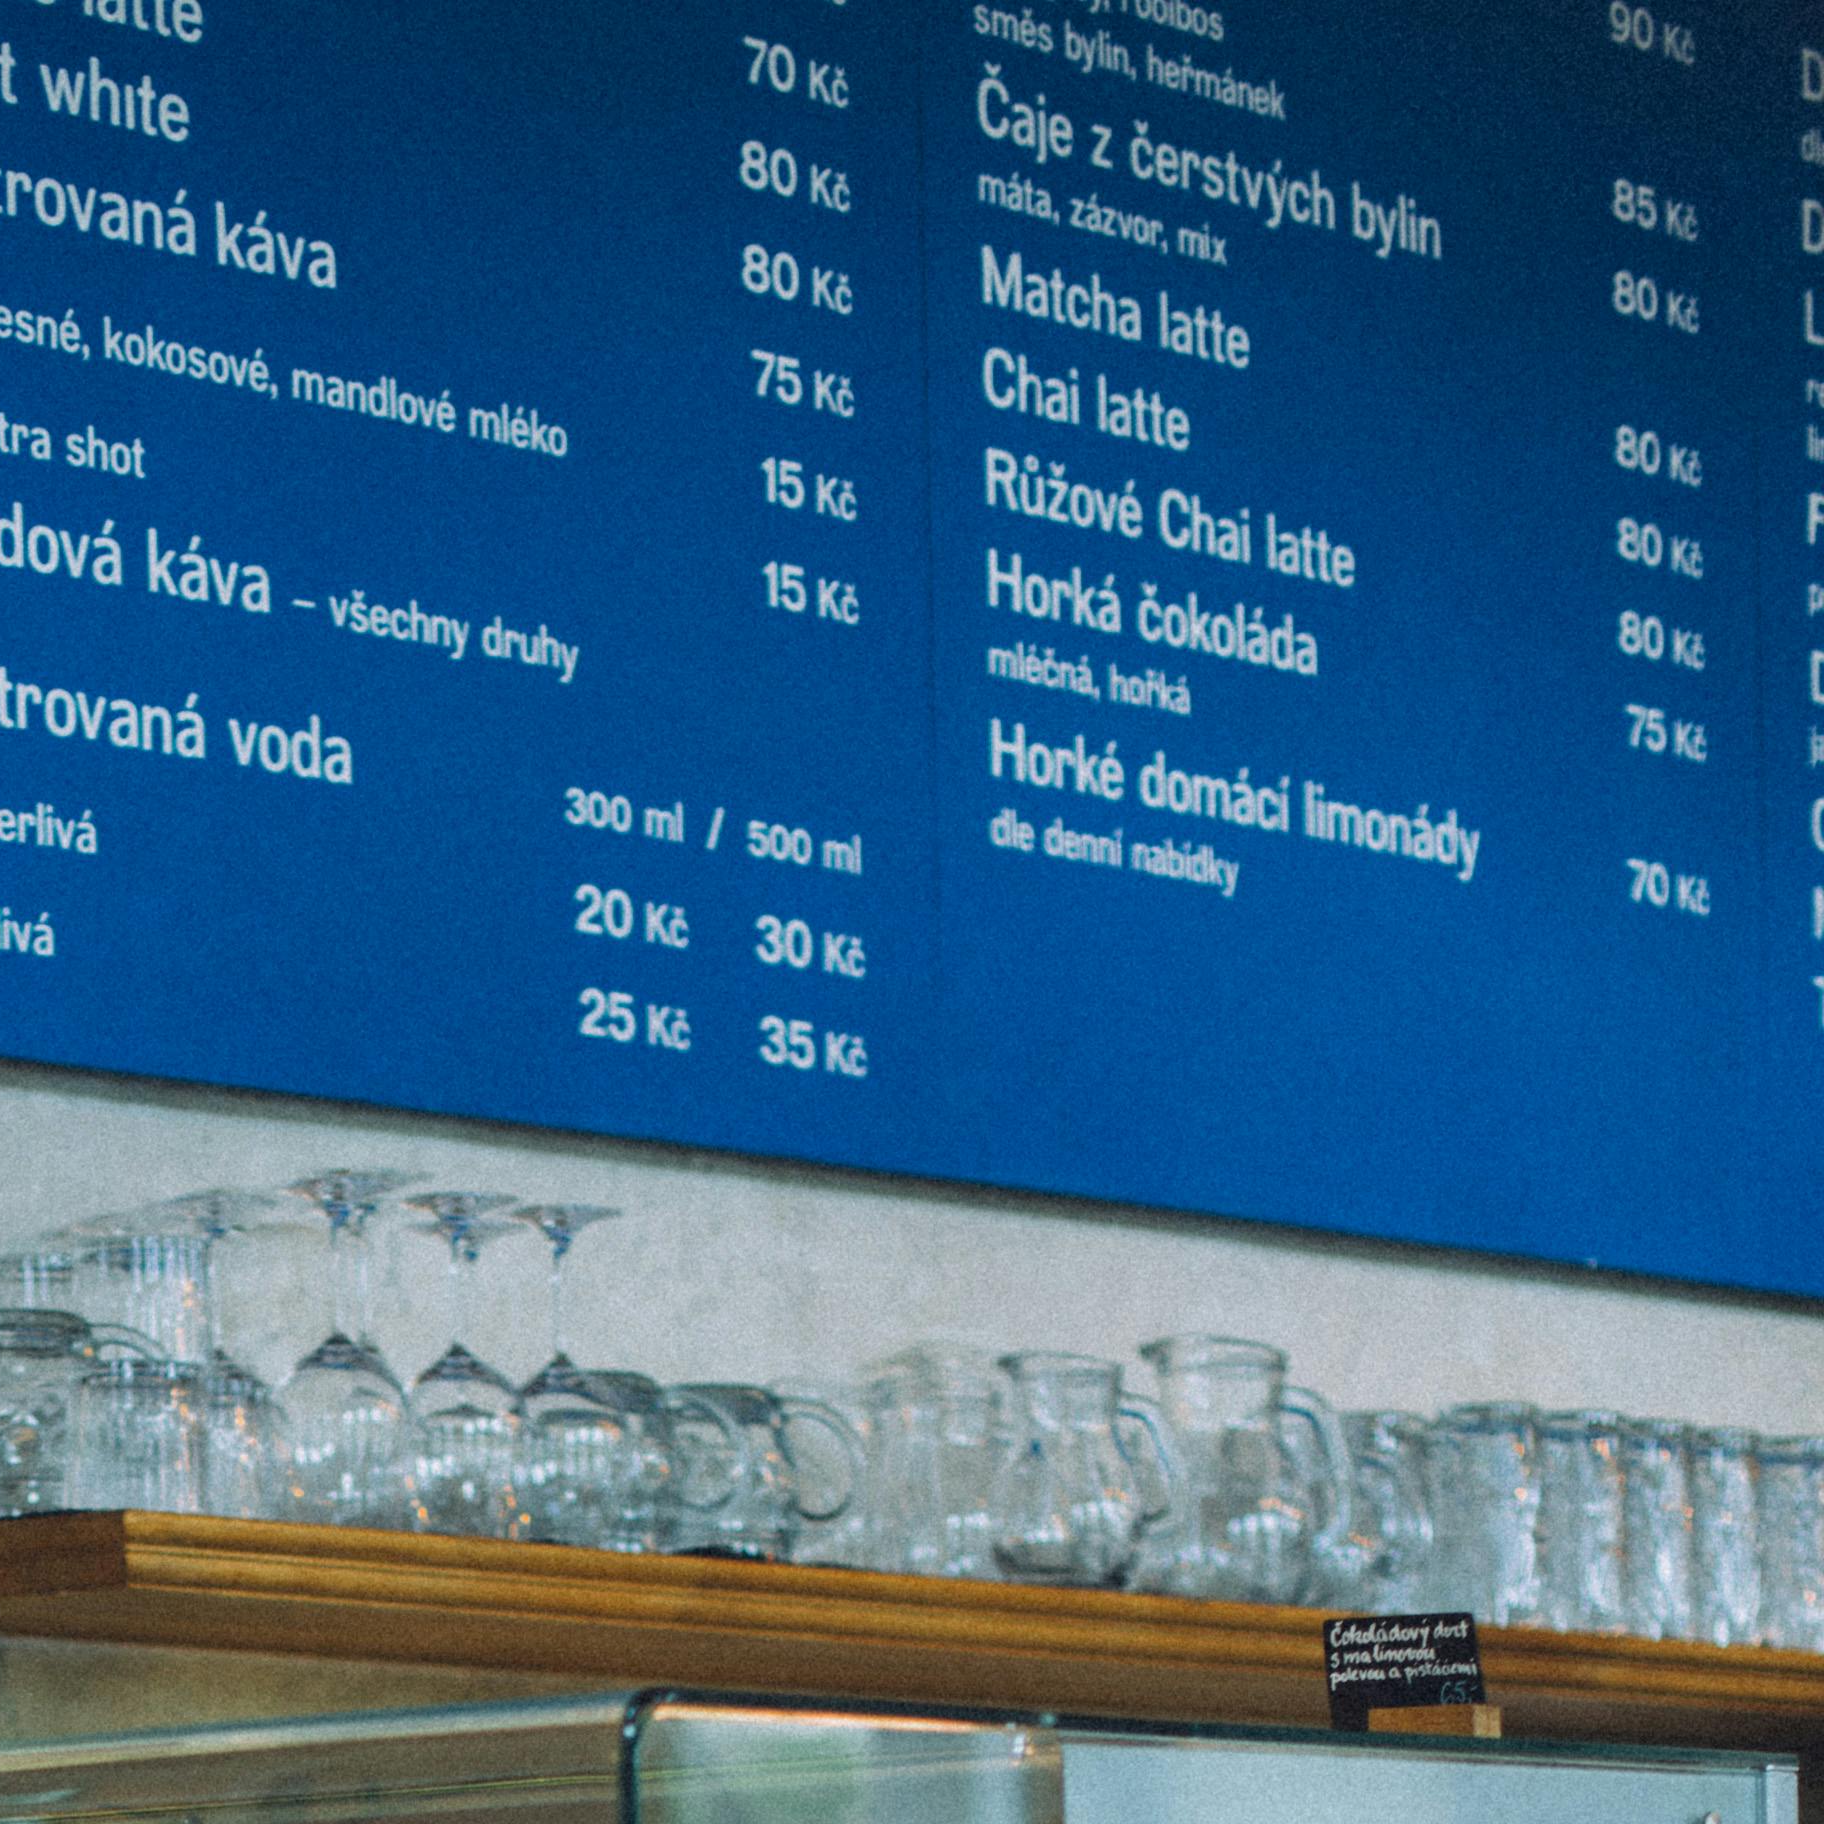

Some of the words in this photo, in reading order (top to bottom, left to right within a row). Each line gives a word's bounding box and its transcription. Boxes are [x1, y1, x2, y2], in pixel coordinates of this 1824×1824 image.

[83, 0, 203, 43] tte
[1610, 0, 1653, 50] 90
[1664, 25, 1693, 64] Kč
[743, 36, 796, 92] 70
[809, 60, 848, 108] Kč
[974, 5, 1053, 52] směs
[1065, 21, 1136, 79] bylin,
[1147, 45, 1285, 118] heřmánek
[40, 56, 190, 142] white
[740, 140, 798, 197] 80
[810, 164, 850, 212] Kč
[977, 62, 1073, 163] Čaje
[1091, 124, 1113, 168] z
[1130, 120, 1336, 229] čerstvých
[1352, 182, 1441, 258] bylin
[215, 201, 337, 289] káva
[978, 172, 1060, 224] máta,
[1070, 194, 1168, 253] zázvor,
[1178, 224, 1227, 264] mix
[1612, 178, 1657, 229] 85
[1666, 201, 1697, 241] Kč
[742, 244, 800, 301] 80
[812, 267, 853, 315] Kč
[981, 245, 1142, 341] Matcha
[1160, 291, 1250, 368] latte
[1613, 270, 1658, 320] 80
[1667, 292, 1699, 333] Kč
[103, 315, 278, 399] kokosové,
[292, 368, 456, 433] mandlové
[469, 403, 568, 457] mléko
[751, 349, 803, 405] 75
[814, 370, 854, 417] Kč
[983, 347, 1080, 424] Chai
[1097, 374, 1190, 451] latte
[66, 425, 145, 479] shot
[1615, 425, 1661, 474] 80
[1669, 445, 1701, 486] Kč
[761, 457, 805, 509] 15
[816, 474, 857, 521] Kč
[985, 447, 1143, 538] Růžové
[1159, 488, 1251, 563] Chai
[1266, 513, 1356, 587] latte
[1617, 517, 1663, 566] 80
[1671, 537, 1703, 578] Kč
[147, 527, 271, 613] káva
[329, 589, 469, 660] všechny
[482, 616, 579, 683] druhy
[763, 561, 807, 612] 15
[818, 578, 859, 625] Kč
[988, 547, 1122, 633] Horká
[1138, 582, 1318, 675] čokoláda
[1618, 610, 1664, 660] 80
[1673, 629, 1705, 670] Kč
[228, 714, 352, 784] voda
[1625, 704, 1667, 752] 75
[1674, 721, 1707, 761] Kč
[565, 787, 632, 833] 300
[644, 801, 684, 842] ml
[706, 807, 725, 850] /
[748, 819, 812, 865] 500
[823, 835, 862, 874] ml
[990, 718, 1124, 800] Horké
[1139, 750, 1290, 832] domácí
[1304, 780, 1480, 881] limonády
[990, 808, 1035, 852] dle
[1131, 838, 1239, 897] nabídky
[1627, 858, 1669, 906] 70
[1677, 875, 1710, 915] Kč
[575, 883, 634, 938] 20
[645, 901, 689, 948] Kč
[756, 914, 813, 968] 30
[824, 932, 865, 978] Kč
[579, 987, 637, 1042] 25
[647, 1004, 691, 1050] Kč
[760, 1015, 816, 1069] 35
[825, 1031, 867, 1077] Kč
[1330, 1653, 1339, 1668] s
[1434, 1619, 1468, 1639] dort
[1330, 1666, 1385, 1692] polevou
[1388, 1666, 1402, 1678] a
